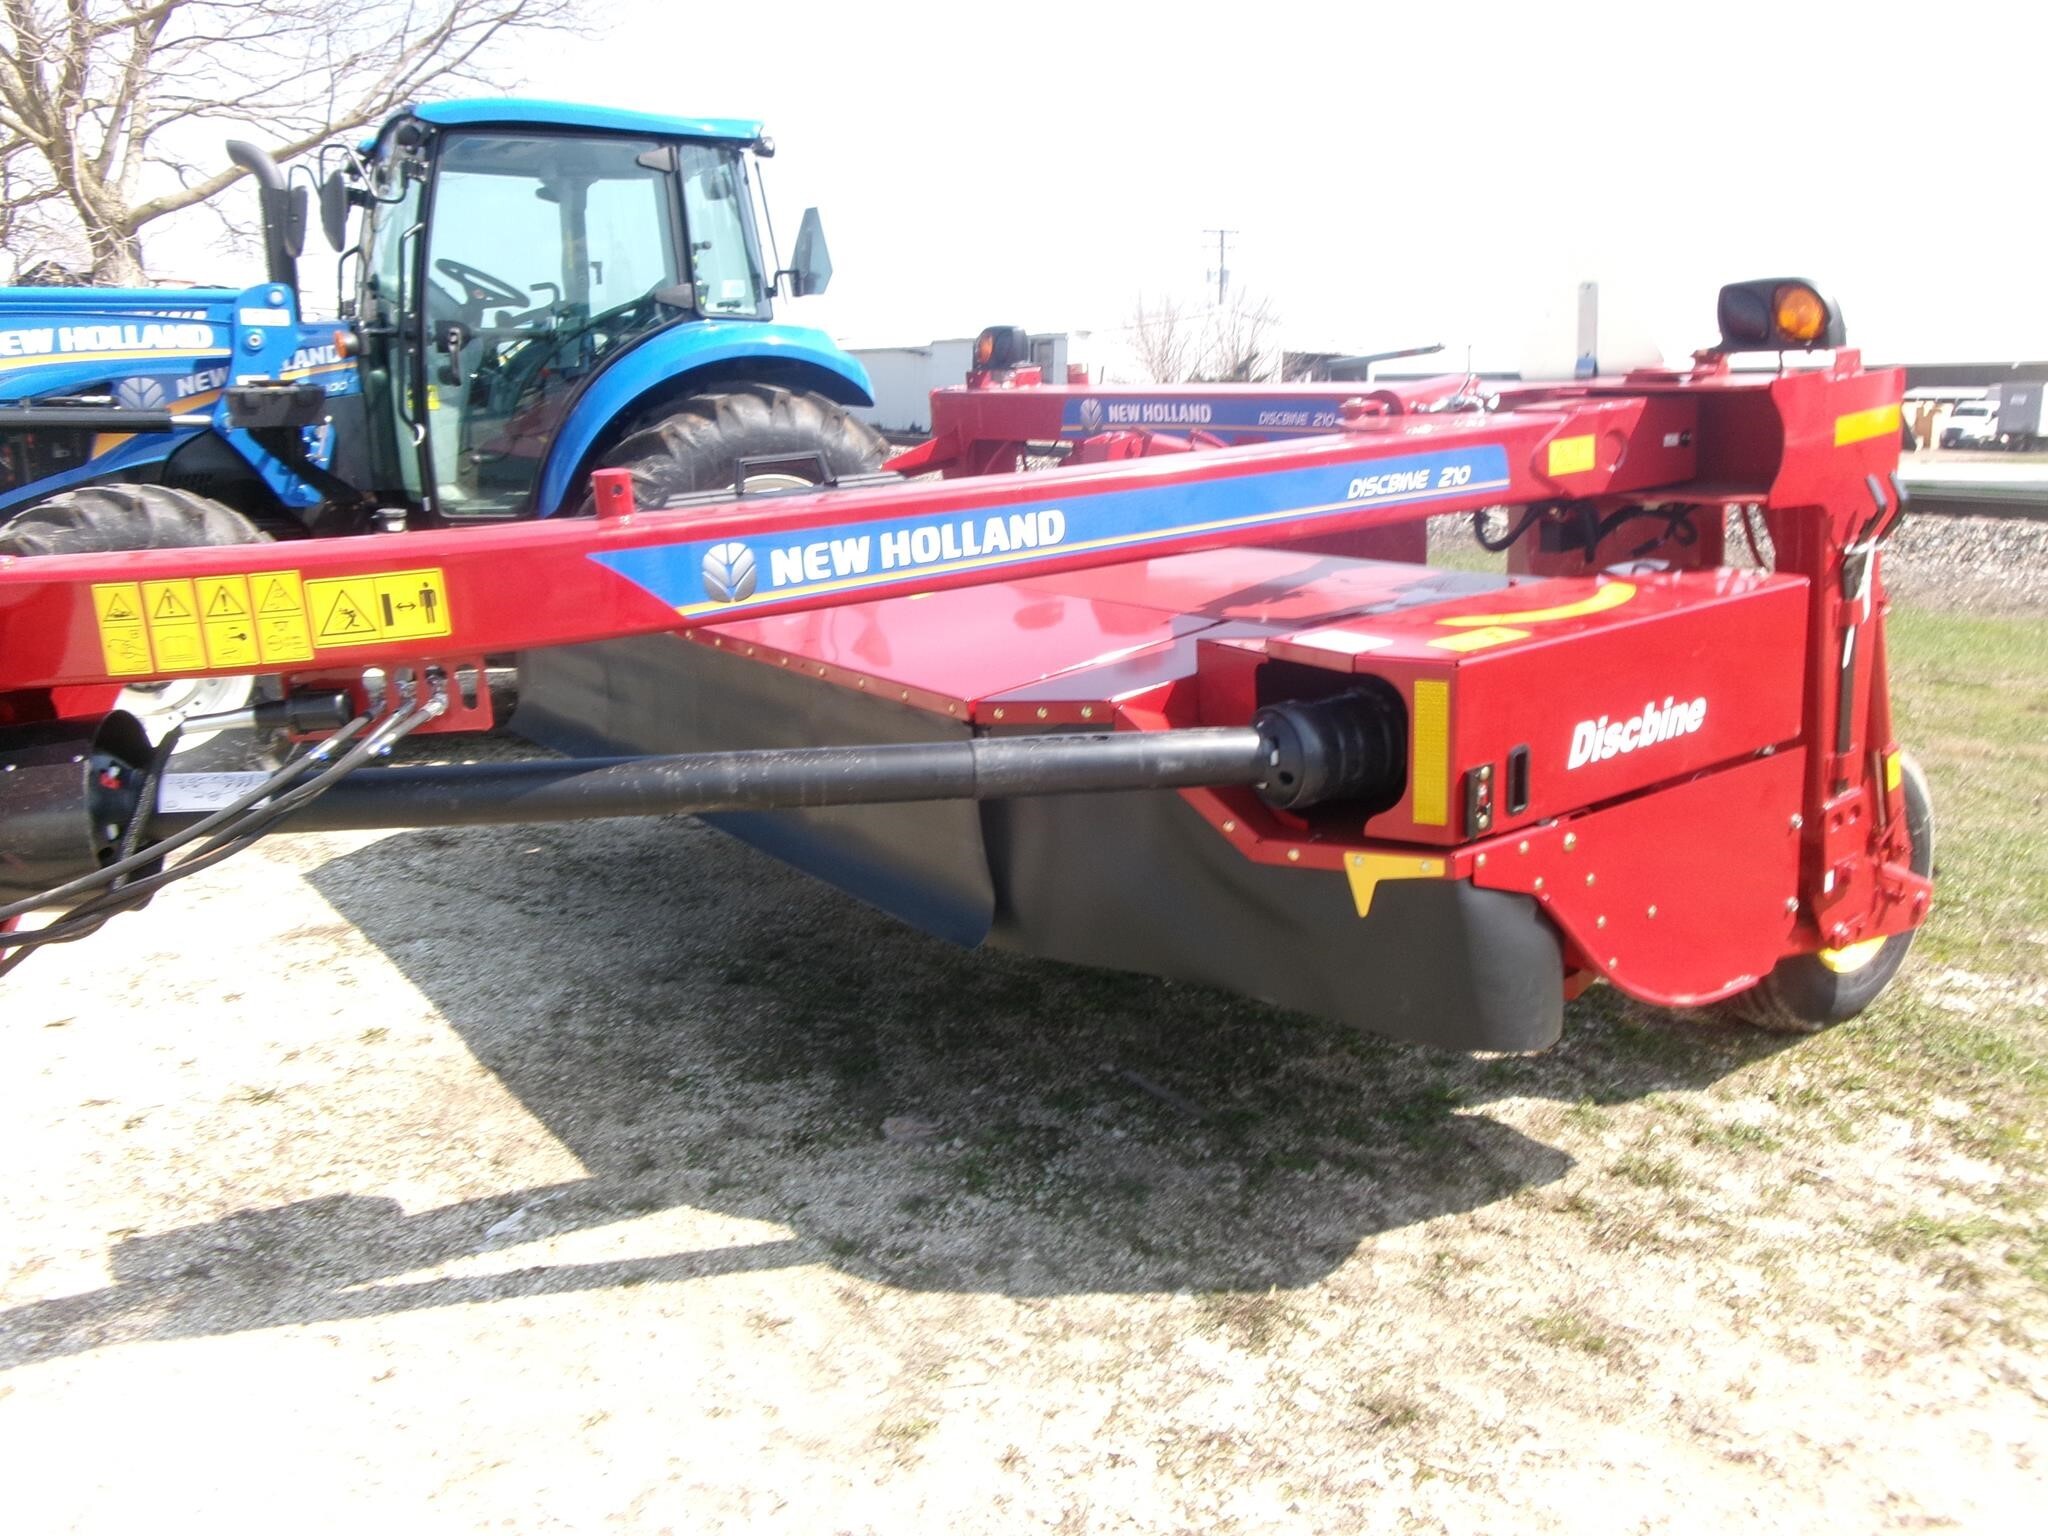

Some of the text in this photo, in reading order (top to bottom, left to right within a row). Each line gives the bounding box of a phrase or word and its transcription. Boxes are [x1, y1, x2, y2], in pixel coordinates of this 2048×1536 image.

[0, 324, 214, 356] EW HOLLAND
[1108, 403, 1212, 424] NEW HOLLAND
[1258, 411, 1336, 427] DISCBINE 210
[1347, 465, 1471, 500] DISCBINE 210
[771, 509, 1066, 587] NEW HOLLAND
[1567, 695, 1708, 770] Discbine
